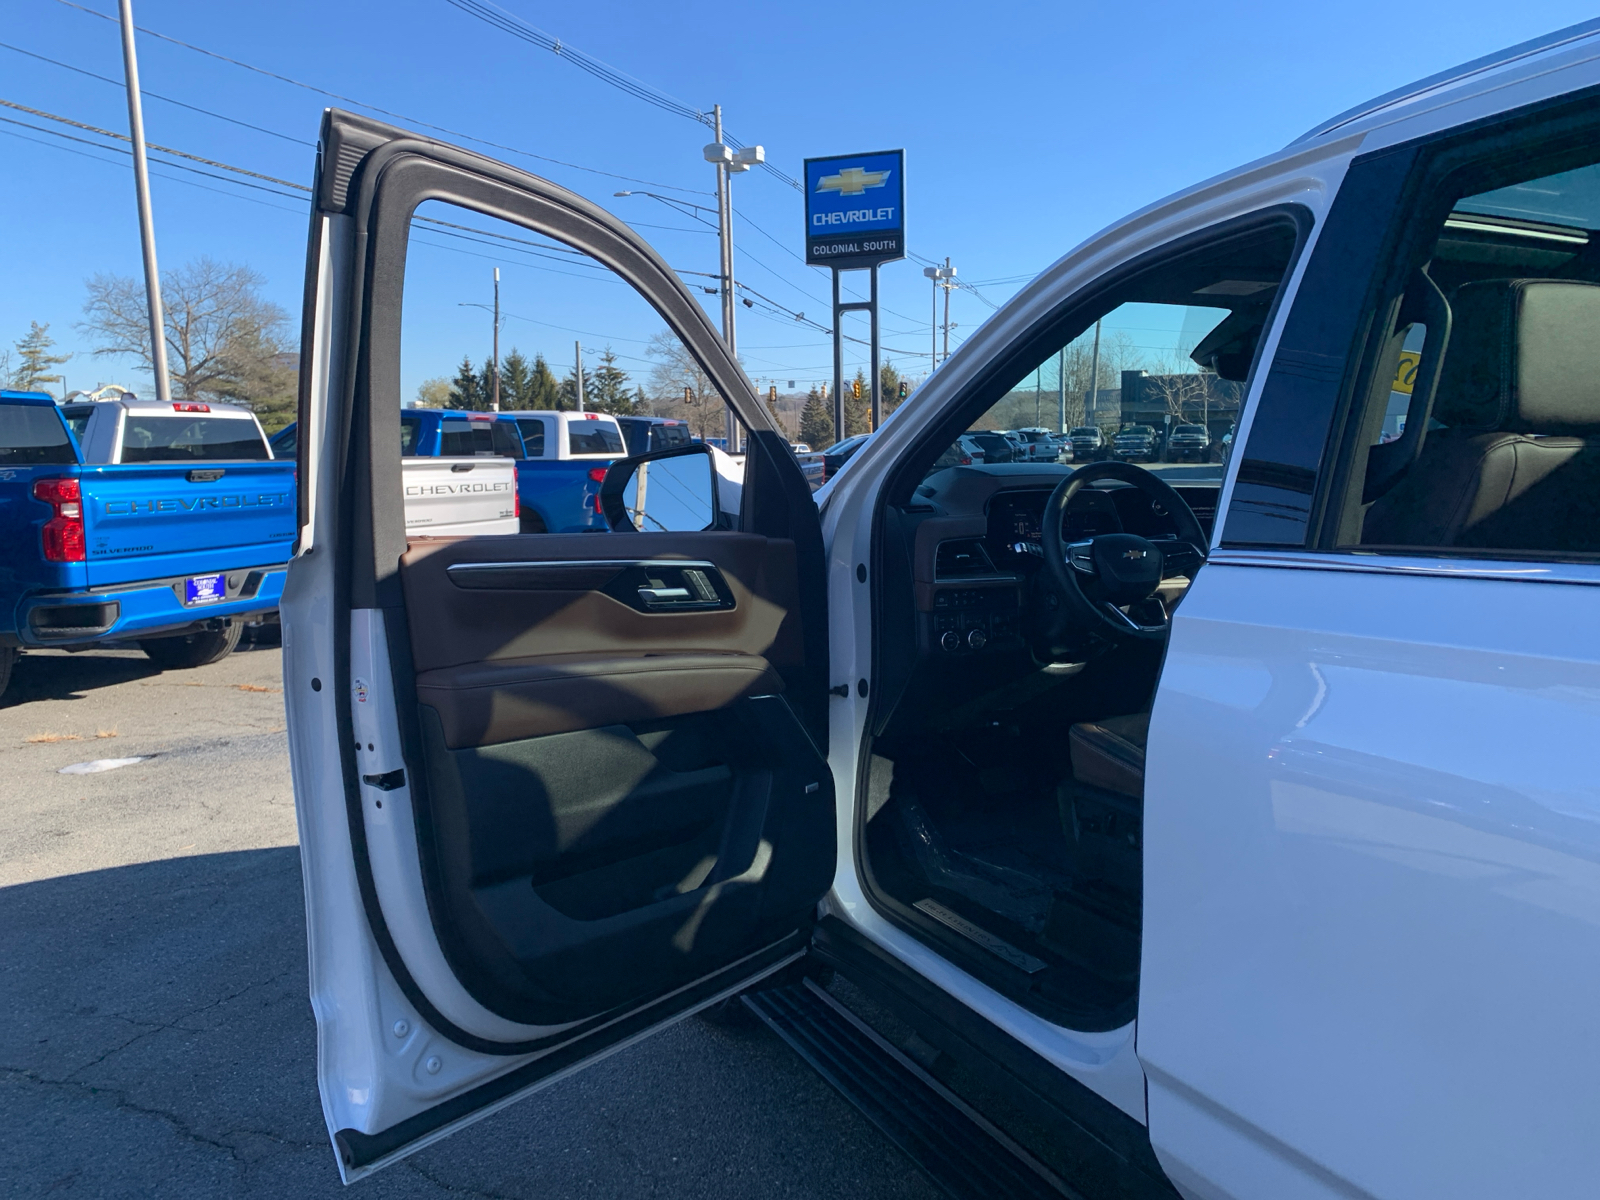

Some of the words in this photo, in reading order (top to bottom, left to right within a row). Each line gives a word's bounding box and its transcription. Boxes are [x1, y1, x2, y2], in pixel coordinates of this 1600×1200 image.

[813, 207, 895, 226] CHEVROLET
[813, 243, 860, 255] COLONIAL
[863, 240, 896, 251] SOUTH
[406, 482, 510, 496] CHEVROLET
[105, 493, 289, 516] CHEVROLET
[92, 545, 154, 555] SILVERADO
